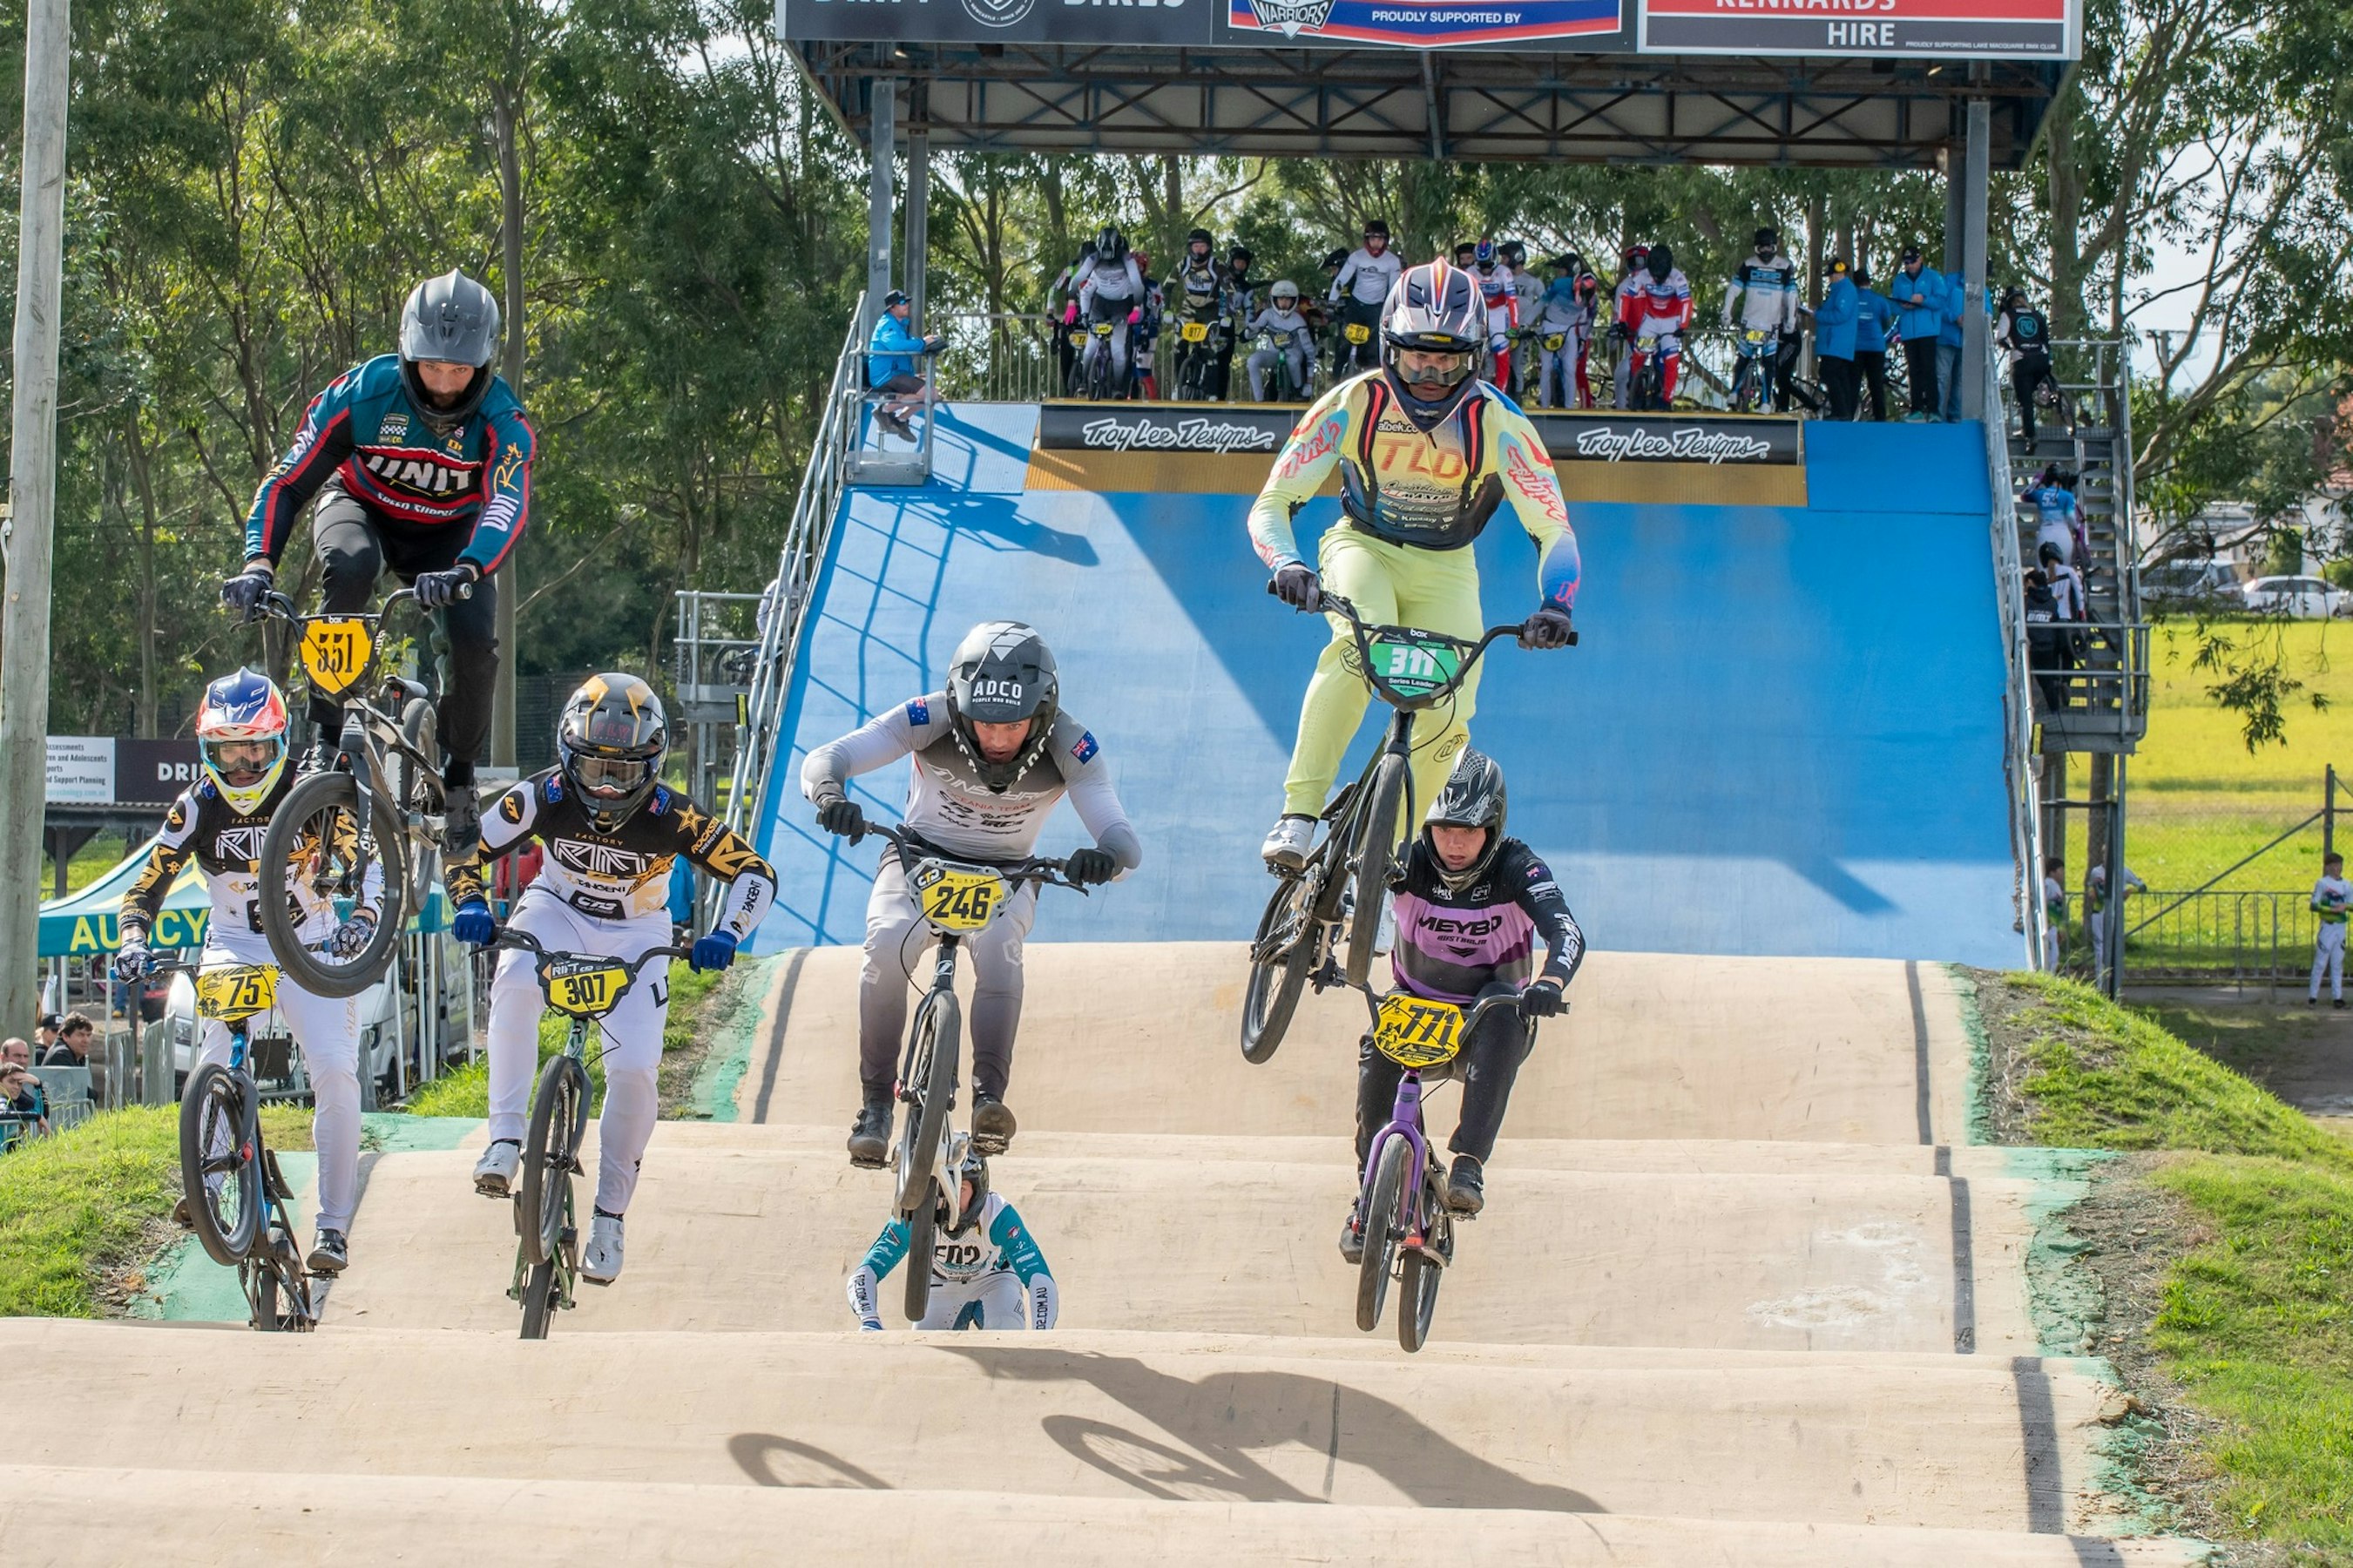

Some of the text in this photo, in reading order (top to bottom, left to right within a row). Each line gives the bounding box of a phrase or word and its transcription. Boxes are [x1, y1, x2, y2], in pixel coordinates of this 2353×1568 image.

[1254, 2, 1328, 25] WARRIORS
[1372, 10, 1521, 24] PROUDLY SUPPORTED BY
[1828, 22, 1896, 46] HIRE
[1082, 417, 1133, 452] Troy
[1132, 418, 1176, 448] Lee
[1175, 417, 1275, 454] Designs
[1577, 426, 1770, 464] Troy Lee Designs
[366, 455, 471, 491] UNIT
[1376, 438, 1464, 478] TLD
[328, 615, 343, 625] box
[1410, 627, 1429, 639] box
[317, 633, 354, 673] 551
[1389, 647, 1437, 677] 311
[973, 679, 1023, 700] ADCO
[1411, 679, 1436, 688] Leader
[54, 775, 78, 785] Support
[79, 775, 106, 786] Planning
[574, 832, 624, 847] FACTORY
[932, 886, 991, 920] 246
[70, 909, 210, 952] AUCY
[1418, 915, 1502, 936] MEYBO
[228, 975, 261, 1007] 75
[564, 974, 605, 1006] 307
[1398, 1004, 1458, 1046] 771
